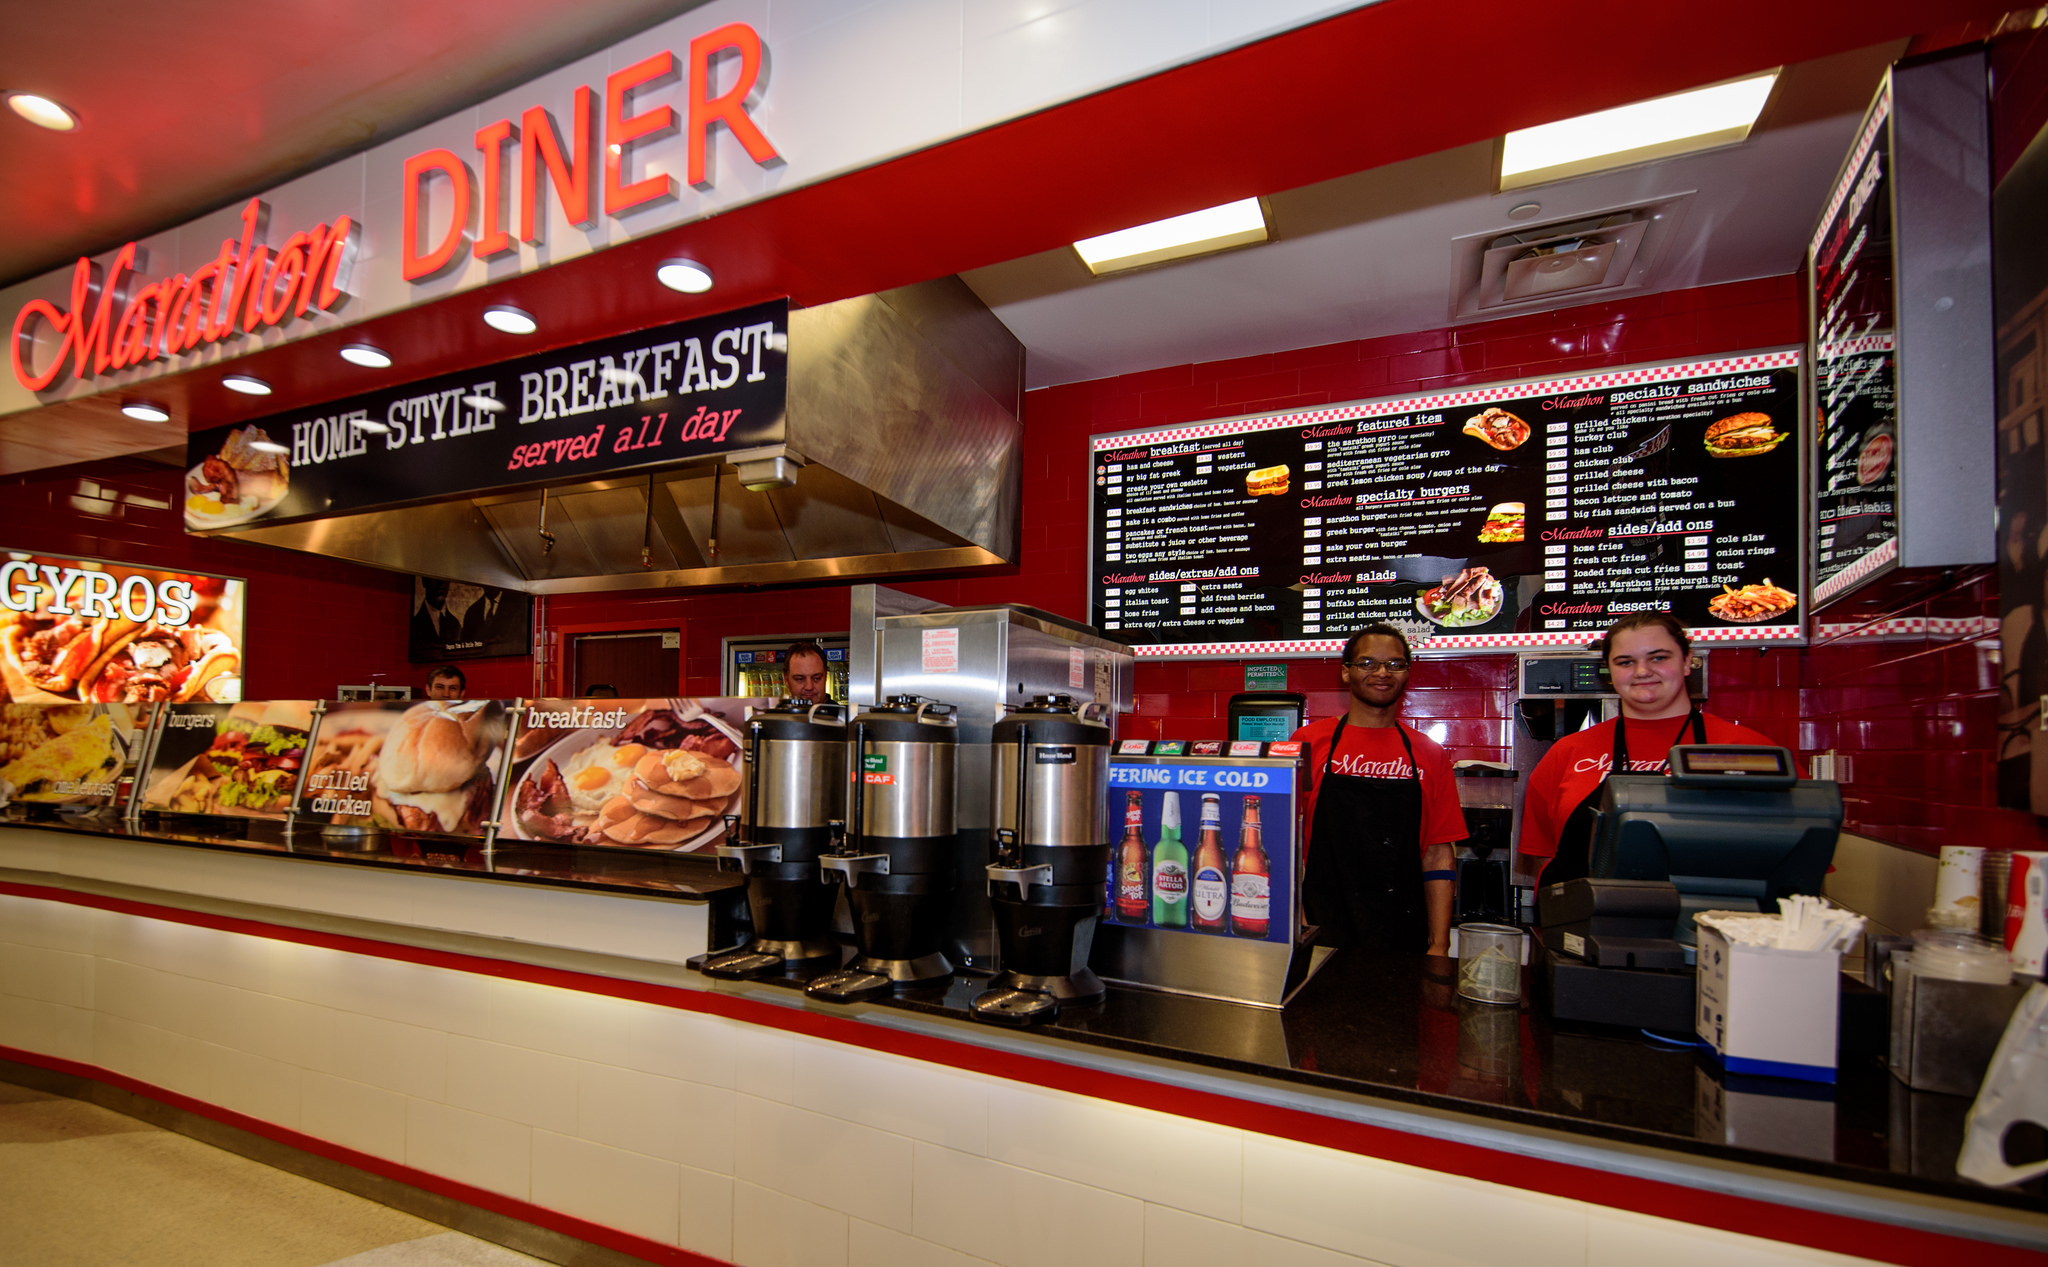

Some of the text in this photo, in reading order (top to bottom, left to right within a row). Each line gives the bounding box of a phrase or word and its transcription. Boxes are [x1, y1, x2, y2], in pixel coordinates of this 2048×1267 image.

[11, 22, 778, 392] Marathon DINER
[290, 322, 773, 467] HOME STYLE BREAKFAST
[1541, 393, 1604, 411] Marathon
[1610, 385, 1682, 403] specialty
[1688, 375, 1771, 393] sandwiches
[1301, 413, 1443, 439] Marathon featured item
[1574, 418, 1609, 430] grilled
[1611, 416, 1647, 425] chicken
[508, 404, 742, 471] served all day
[1342, 437, 1377, 446] marathon
[1377, 435, 1397, 443] gyro
[1574, 430, 1628, 443] turkey club
[1104, 449, 1148, 462] Marathon
[1150, 442, 1201, 456] breakfast
[1327, 449, 1450, 469] mediterranean vegetarian gyro
[1217, 462, 1256, 472] vegetarian
[1327, 479, 1349, 488] greek
[1351, 477, 1373, 485] lemon
[1374, 474, 1404, 483] chicken
[1455, 466, 1465, 475] of
[1467, 465, 1483, 474] the
[1484, 464, 1500, 473] day
[1574, 477, 1699, 494] grilled cheese with bacon
[1301, 494, 1353, 508] Marathon
[1356, 489, 1415, 503] specialty
[1420, 484, 1470, 497] burgers
[1574, 490, 1693, 506] bacon lettuce and tomato
[1574, 510, 1590, 518] big
[1592, 508, 1612, 517] fish
[1614, 504, 1657, 515] sandwich
[1659, 502, 1691, 512] served
[1717, 500, 1736, 508] bun
[1326, 515, 1360, 524] marathon
[1361, 513, 1388, 521] burger
[1540, 520, 1714, 541] Marathon sides/add ons
[1716, 533, 1766, 543] cole slaw
[1716, 546, 1776, 557] onion rings
[1573, 565, 1681, 577] loaded fresh cut fries
[1716, 561, 1745, 570] toast
[1102, 566, 1259, 585] Marathon sides/extras/add ons
[1300, 570, 1397, 585] Marathon salads
[1573, 574, 1739, 590] make it Marathon Pittsburgh Style
[0, 558, 193, 627] GYROS
[1124, 586, 1159, 596] egg whites
[1201, 583, 1221, 591] extra
[1347, 587, 1369, 595] salad
[1237, 593, 1265, 601] berries
[1326, 597, 1412, 608] buffalo chicken salad
[1540, 601, 1671, 615] Marathon desserts
[1326, 624, 1348, 632] chef's
[1407, 626, 1431, 634] salad
[1573, 619, 1593, 627] rice
[168, 709, 216, 731] burgers
[527, 705, 628, 730] breakfast
[1123, 742, 1144, 750] Coke
[1233, 742, 1256, 751] Coke
[307, 770, 368, 793] grilled
[1179, 769, 1208, 785] ICE
[1214, 771, 1269, 788] COLD
[311, 795, 372, 816] chicken
[1158, 881, 1183, 890] ARTOIS
[1159, 875, 1183, 883] STELLA
[1121, 885, 1144, 895] SHOCK
[1129, 891, 1143, 900] TOP
